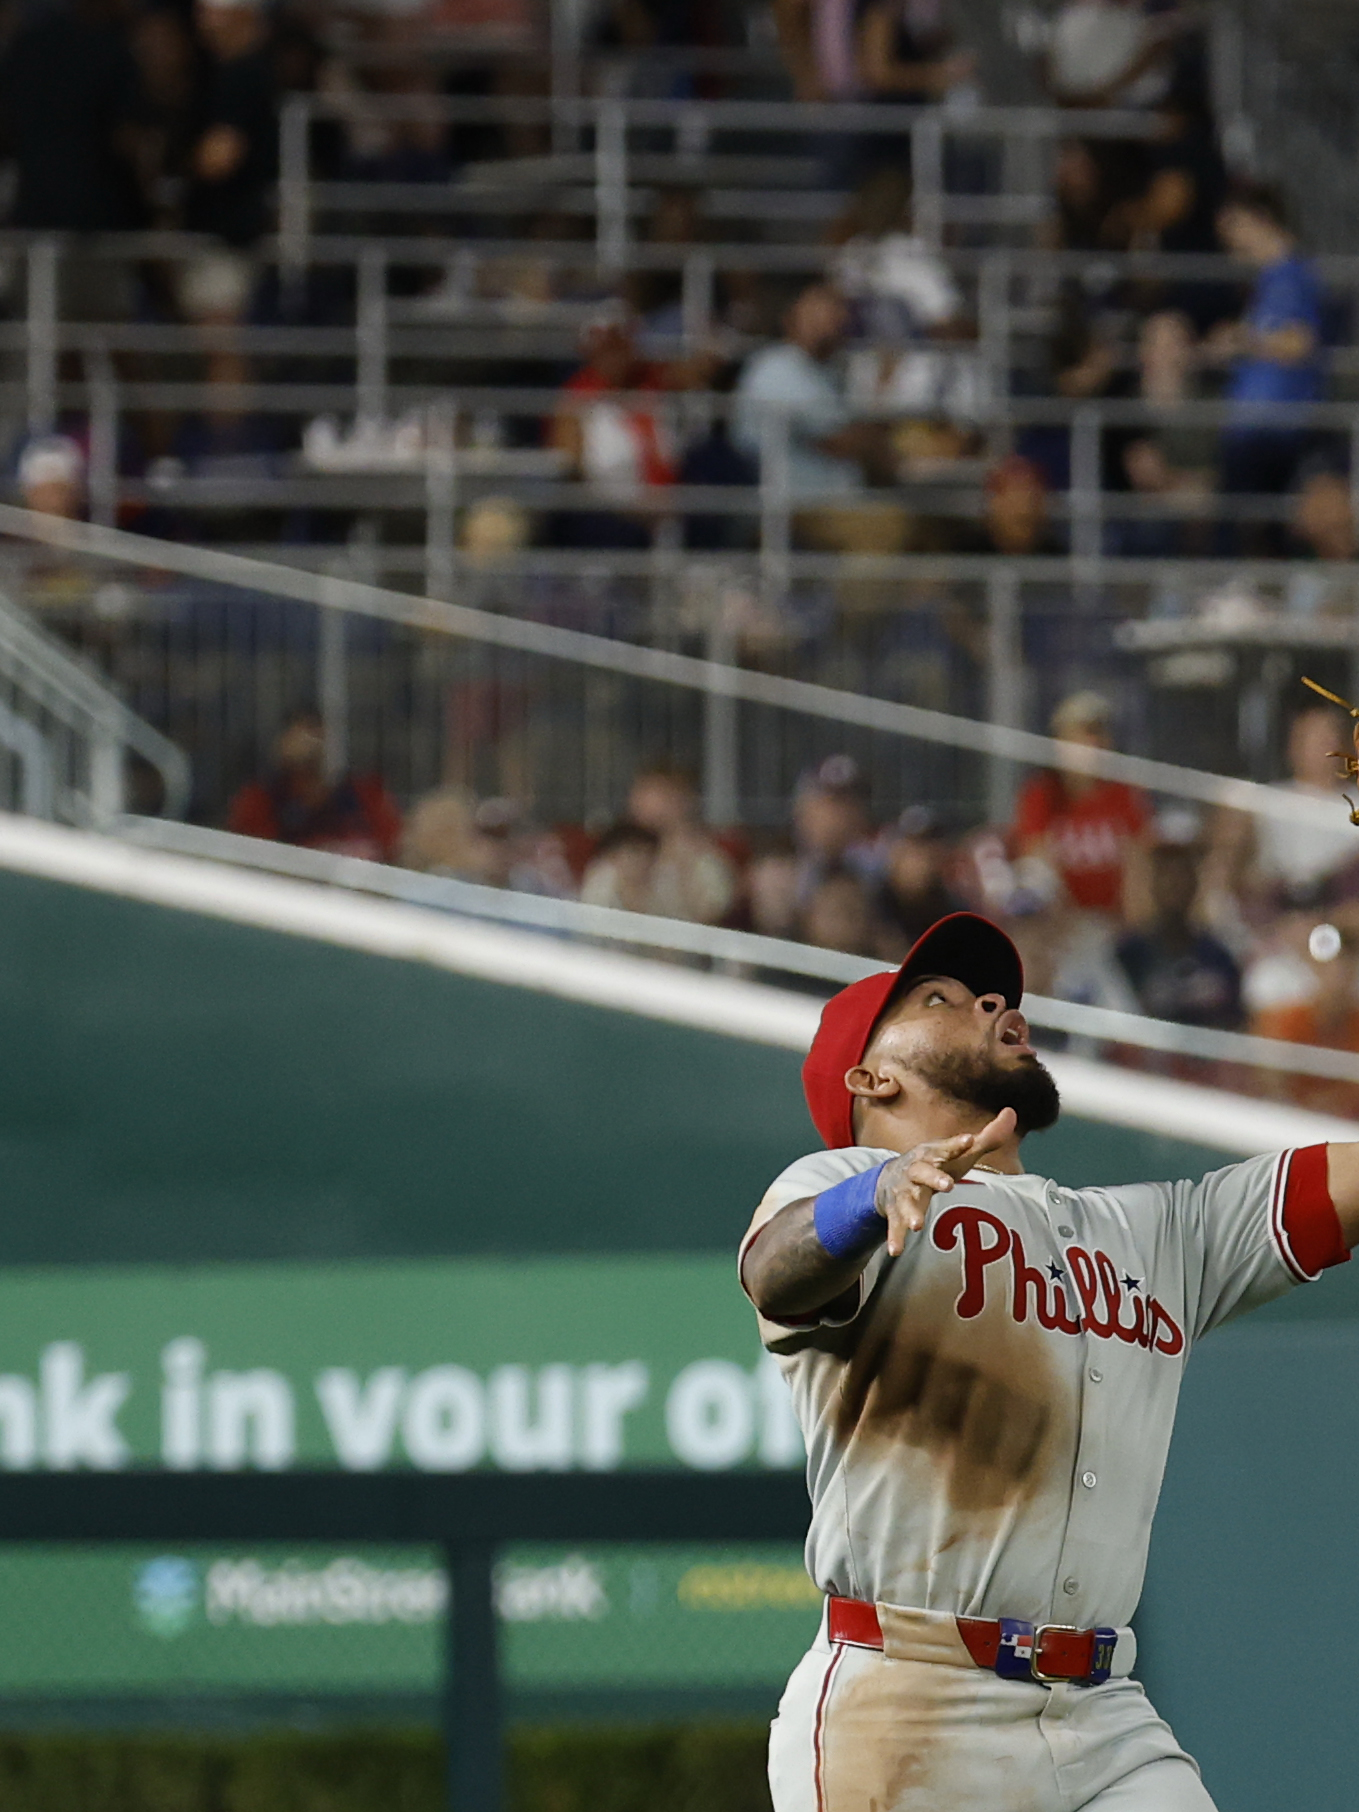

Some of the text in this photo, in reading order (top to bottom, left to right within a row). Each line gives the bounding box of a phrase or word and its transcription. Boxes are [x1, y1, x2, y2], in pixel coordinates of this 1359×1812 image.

[160, 1336, 297, 1472] in
[206, 1557, 449, 1626] MainStree
[492, 1555, 608, 1622] ank
